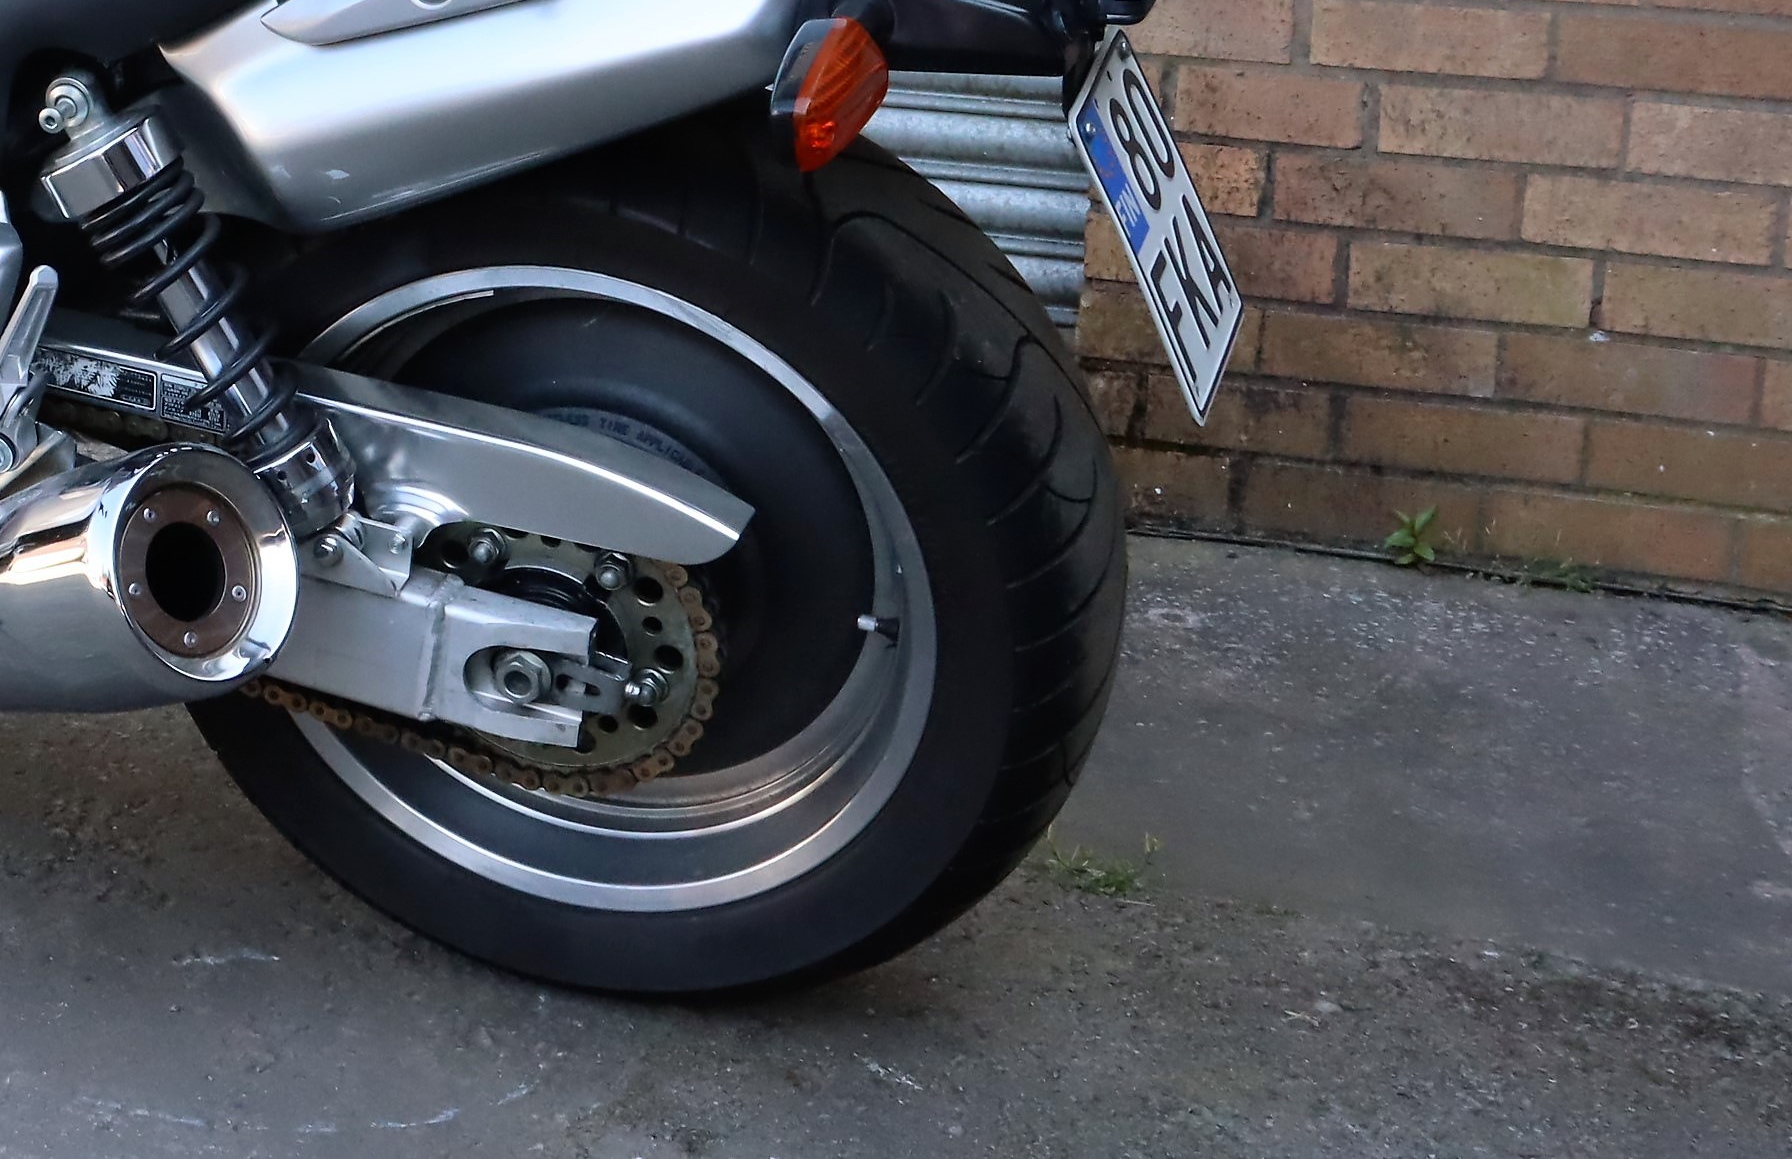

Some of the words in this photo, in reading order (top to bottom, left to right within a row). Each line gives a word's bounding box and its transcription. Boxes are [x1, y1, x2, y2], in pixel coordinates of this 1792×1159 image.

[1109, 68, 1176, 211] 80
[1115, 183, 1142, 239] FIN
[1150, 193, 1232, 383] FKA
